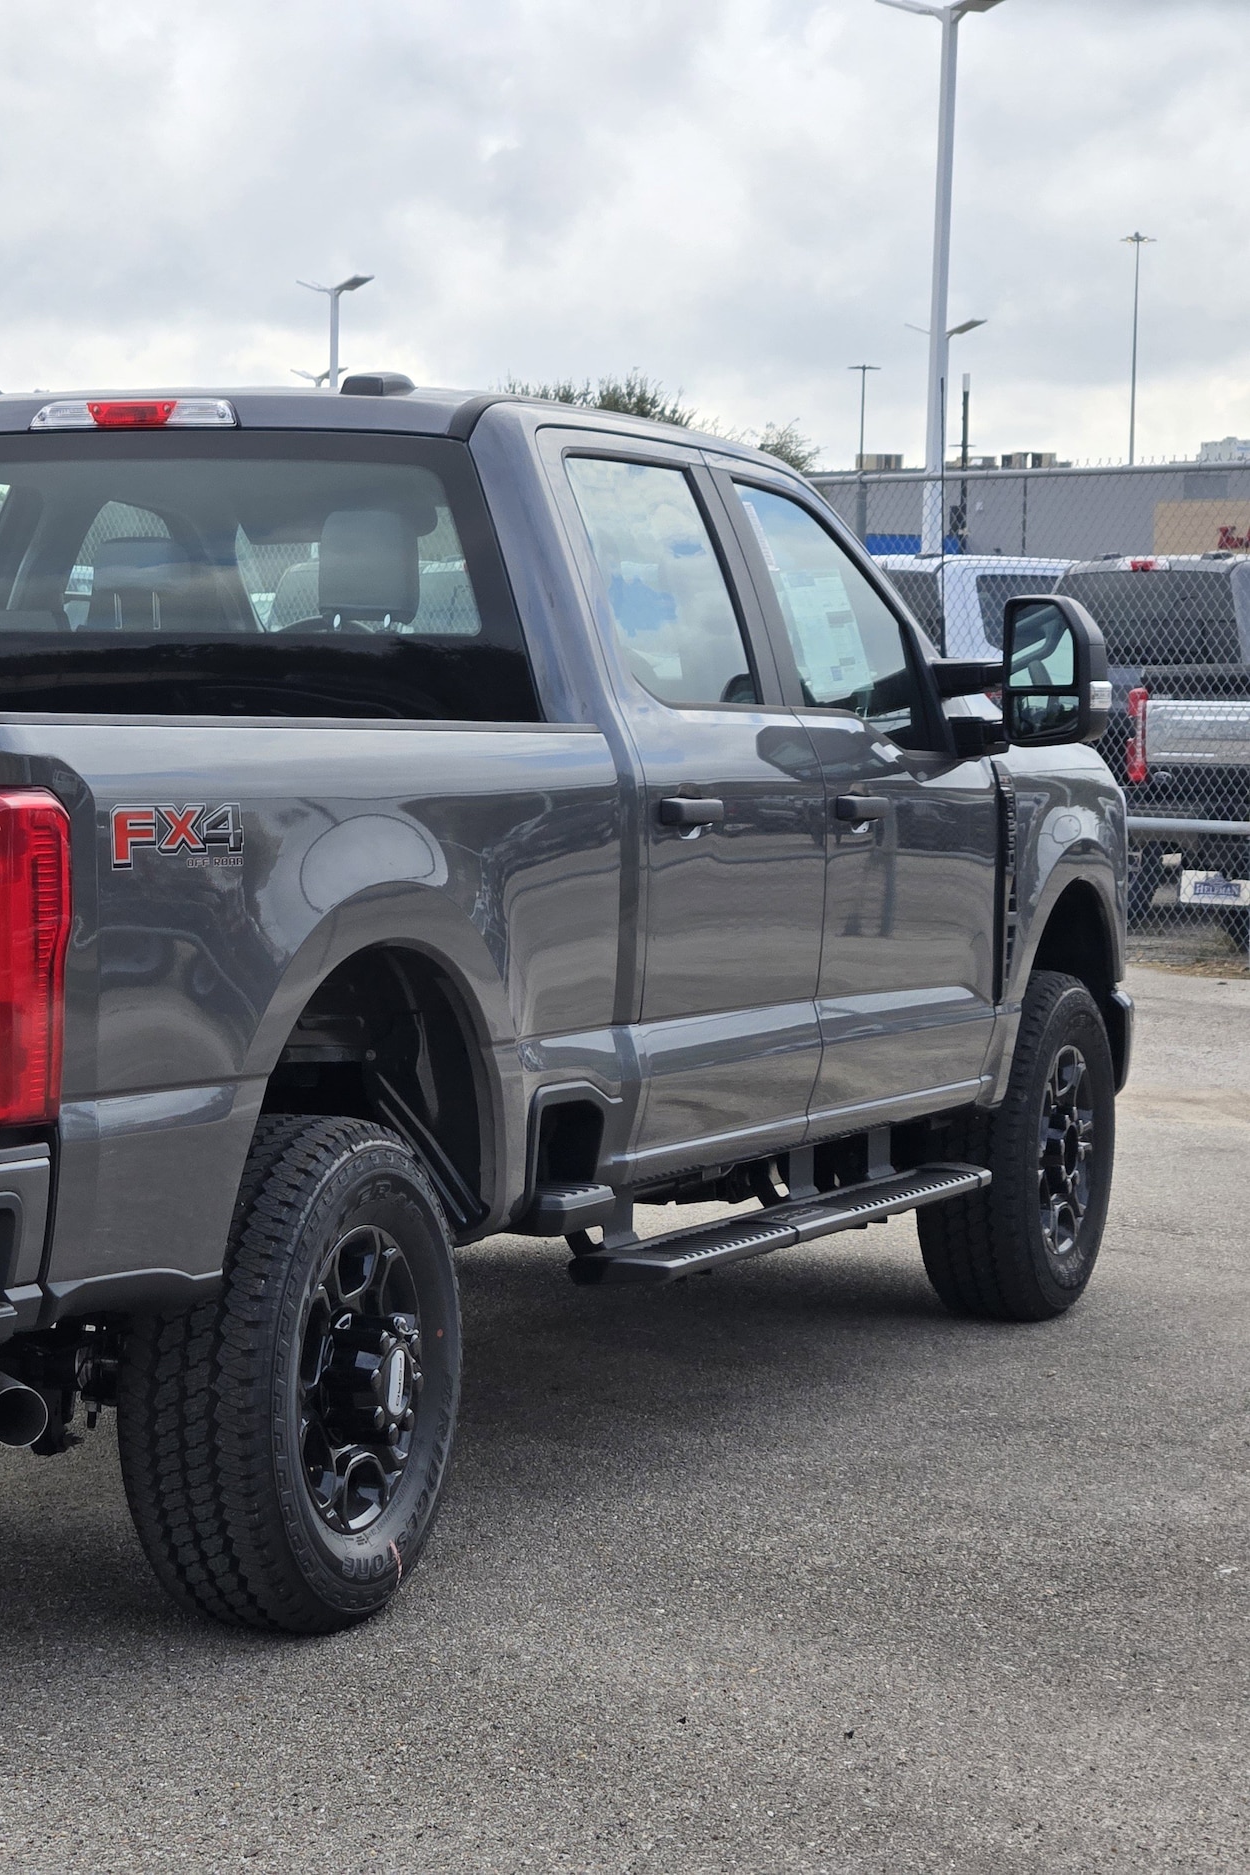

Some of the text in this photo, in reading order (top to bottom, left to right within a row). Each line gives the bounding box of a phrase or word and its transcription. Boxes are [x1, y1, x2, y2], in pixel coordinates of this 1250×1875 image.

[110, 802, 245, 871] FX4
[186, 855, 244, 868] OFF ROAD
